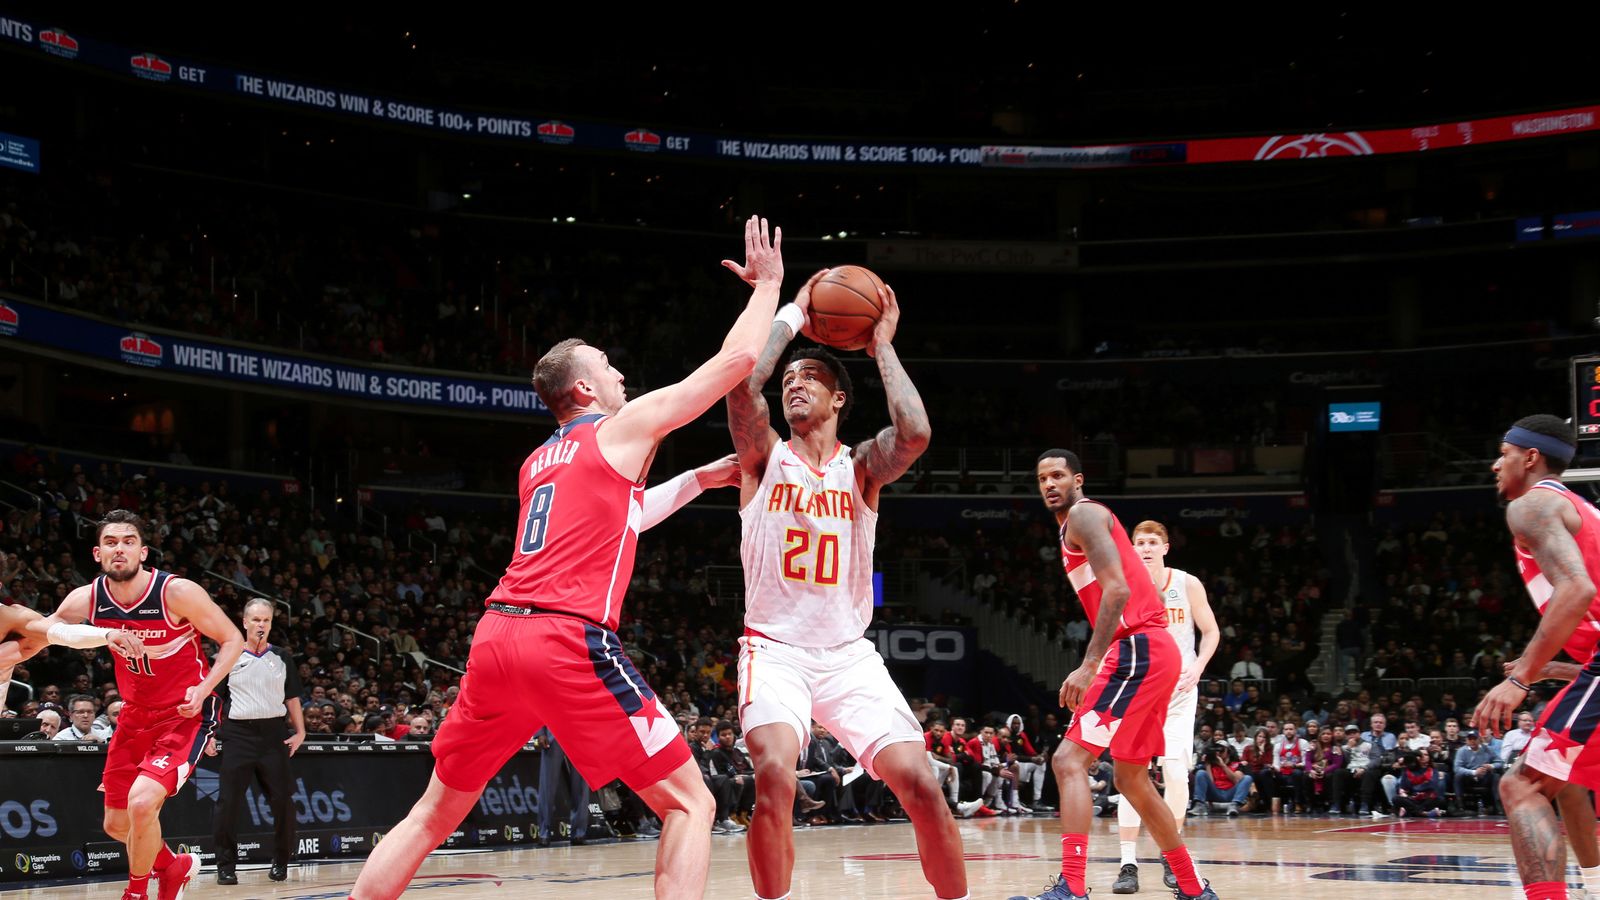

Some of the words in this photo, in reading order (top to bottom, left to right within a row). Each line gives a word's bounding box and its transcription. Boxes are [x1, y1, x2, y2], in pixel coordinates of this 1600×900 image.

[179, 65, 206, 83] GET
[267, 80, 337, 108] WIZARDS
[340, 93, 369, 114] WIN
[372, 100, 385, 116] &
[388, 102, 434, 125] SCORE
[437, 112, 473, 131] 100+
[478, 117, 532, 137] POINTS
[1512, 112, 1595, 136] WASHINGTON
[666, 136, 690, 151] GET
[743, 142, 808, 161] WIZARDS
[811, 145, 841, 161] WIN
[844, 146, 856, 161] &
[859, 146, 907, 163] SCORE
[910, 147, 947, 164] 100+
[173, 344, 223, 373] WHEN
[228, 353, 259, 378] THE
[262, 358, 333, 388] WIZARDS
[336, 369, 366, 393] WIN
[369, 376, 382, 395] &
[386, 377, 442, 401] SCORE
[447, 383, 488, 405] 100+
[530, 440, 580, 480] DEKKER
[768, 482, 854, 521] ATLANTA
[520, 482, 555, 555] 8
[782, 527, 841, 587] 20
[588, 803, 603, 814] WGL
[0, 799, 58, 839] os
[237, 843, 260, 852] Hampshire
[297, 838, 320, 854] ARE
[341, 835, 364, 844] Washington
[30, 854, 61, 865] Hampshire
[87, 851, 120, 862] Washington
[237, 850, 247, 858] Gas
[32, 861, 45, 870] Gas
[87, 860, 100, 868] Gas
